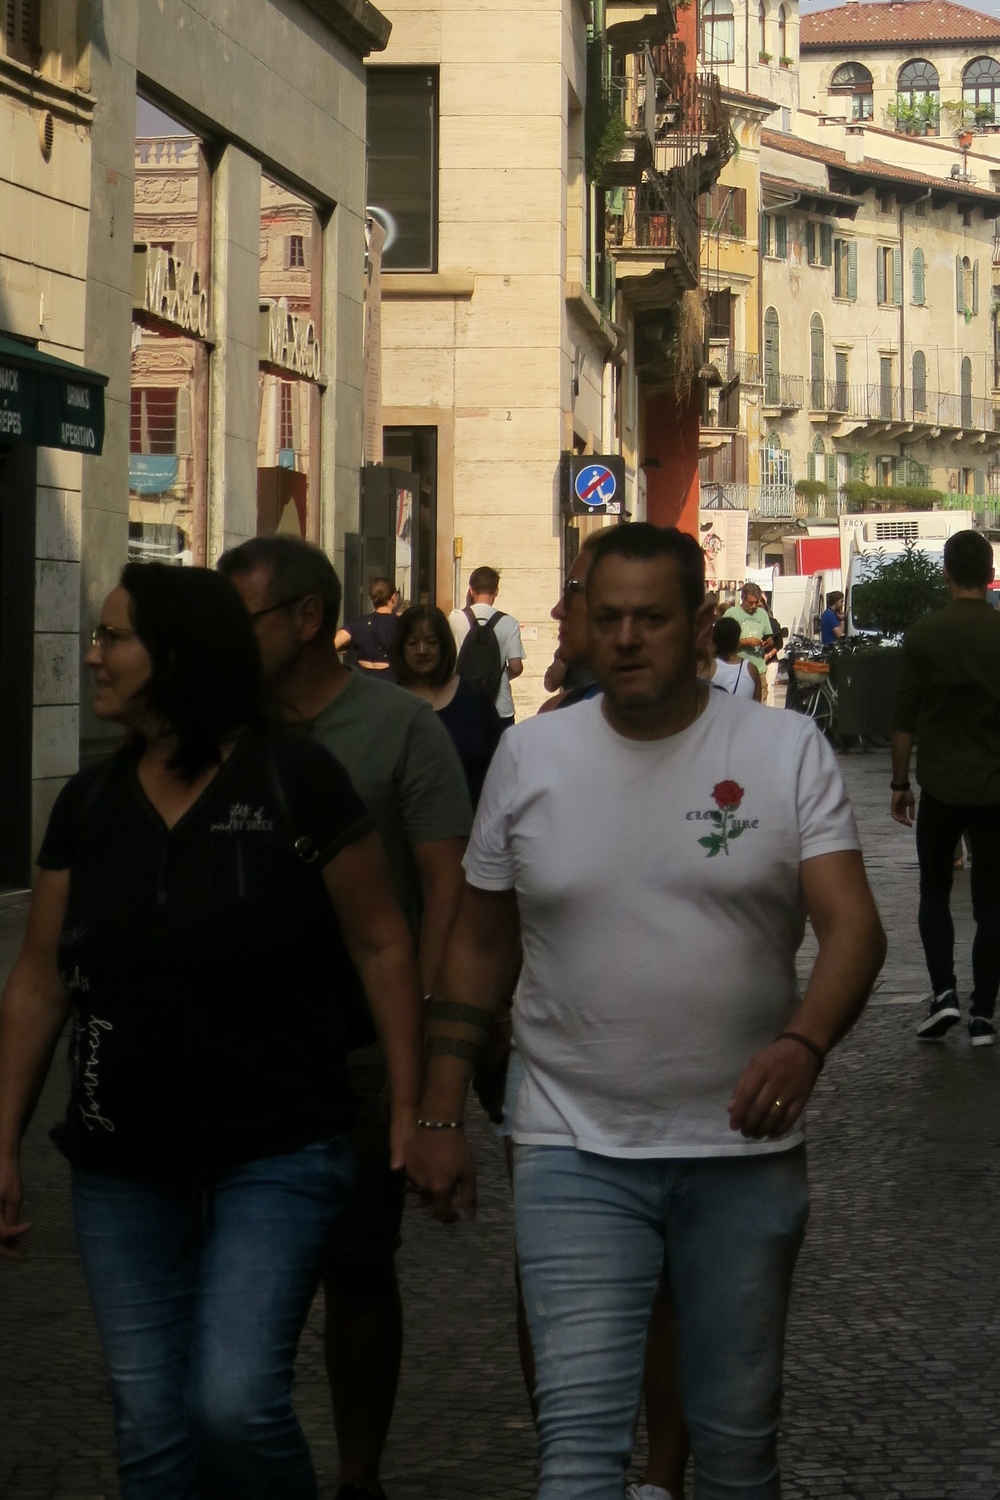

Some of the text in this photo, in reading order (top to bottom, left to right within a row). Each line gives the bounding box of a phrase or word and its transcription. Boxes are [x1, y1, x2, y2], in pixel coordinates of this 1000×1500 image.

[505, 410, 512, 421] 2
[61, 422, 95, 448] APERITIVO
[79, 1014, 115, 1132] Journey
